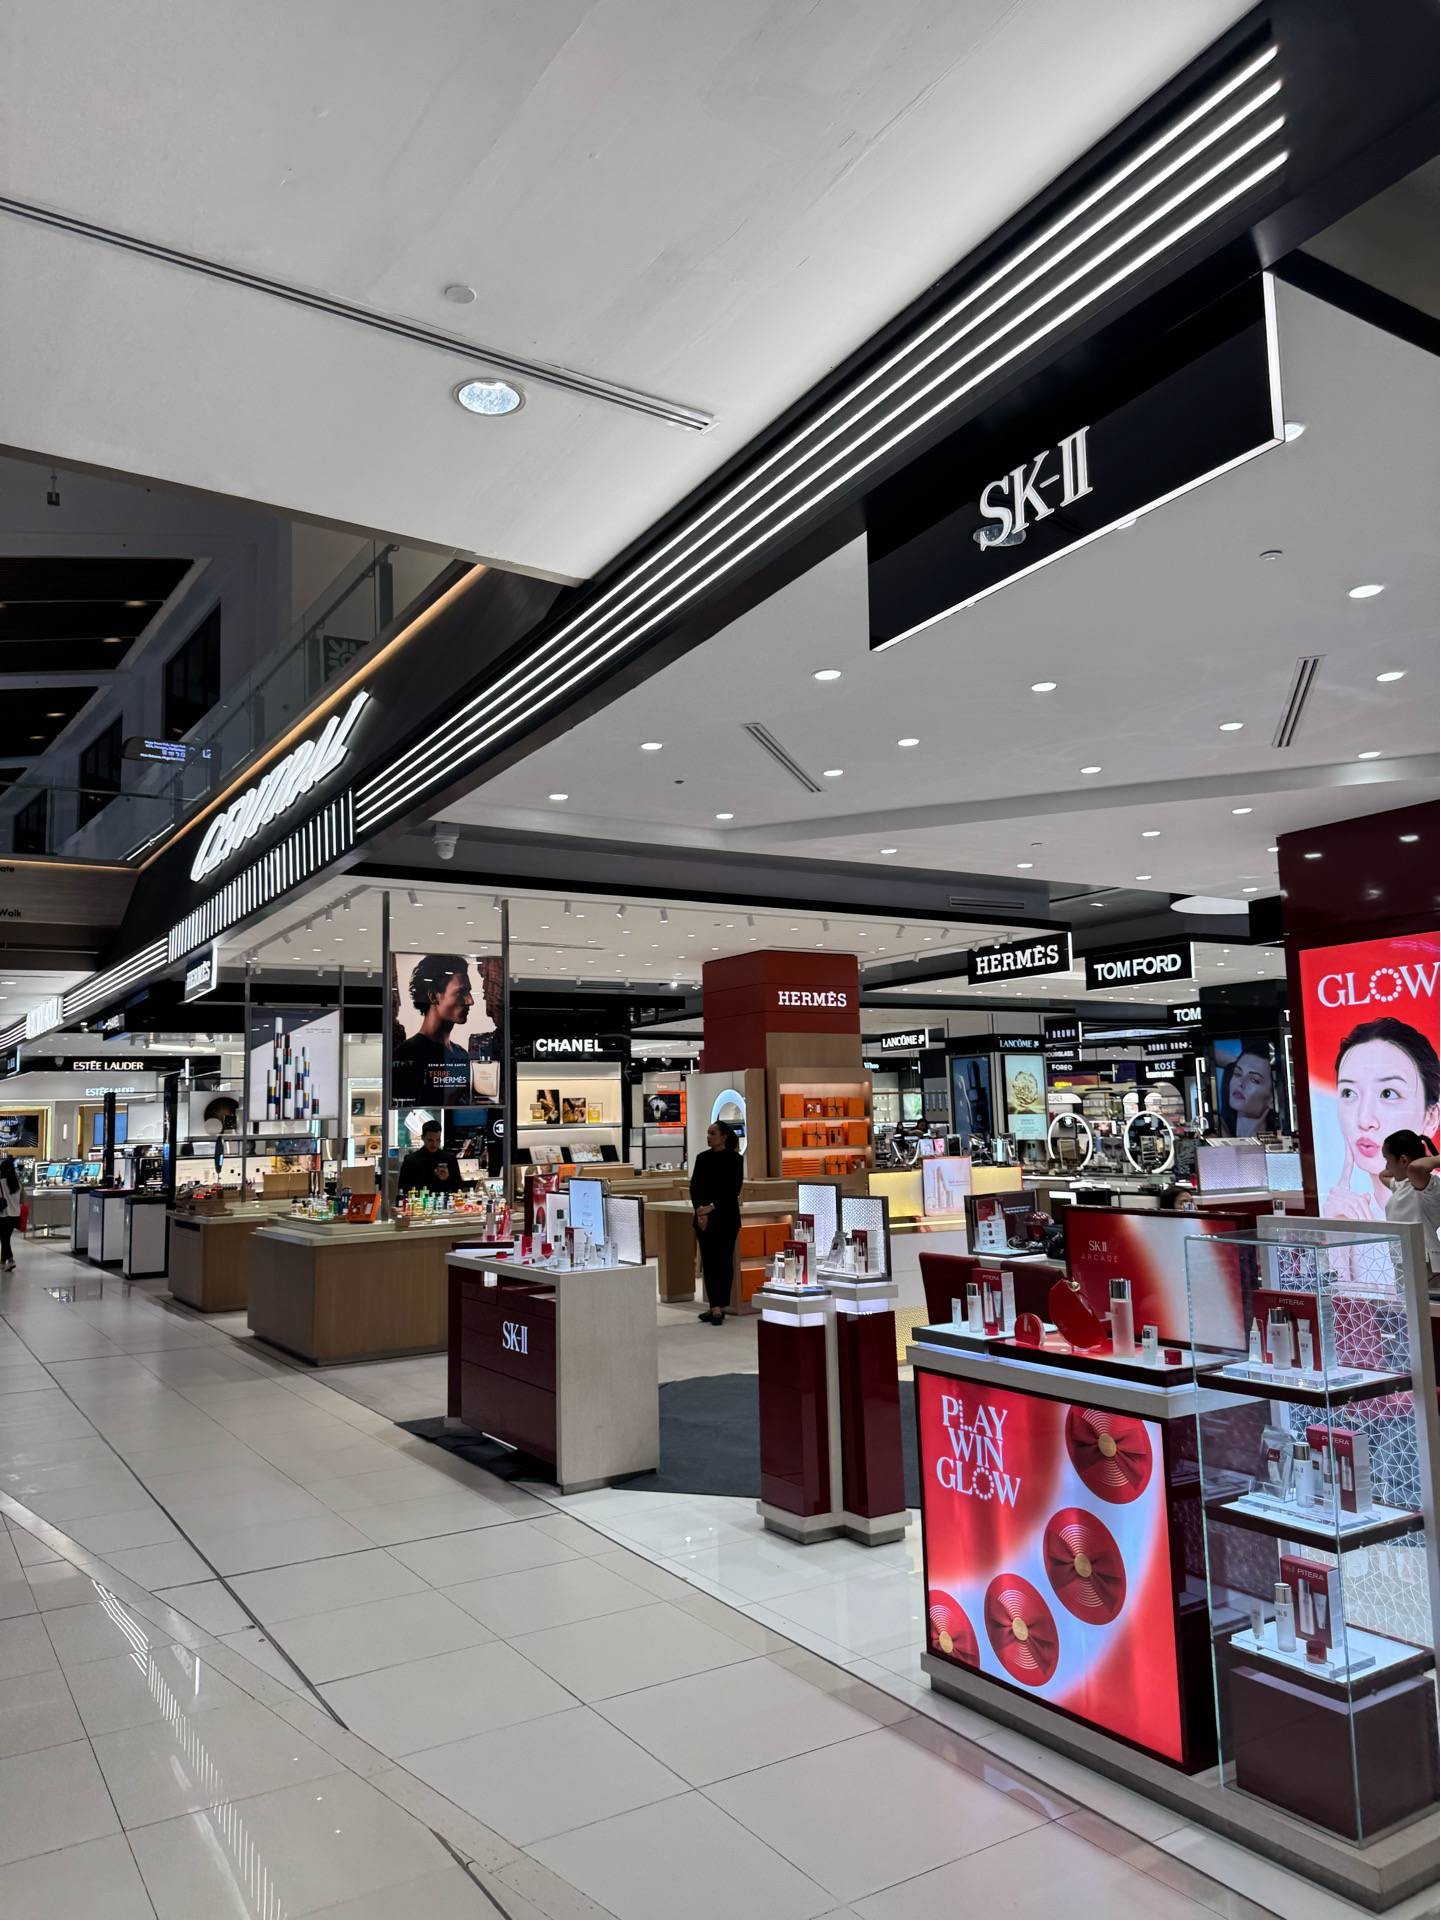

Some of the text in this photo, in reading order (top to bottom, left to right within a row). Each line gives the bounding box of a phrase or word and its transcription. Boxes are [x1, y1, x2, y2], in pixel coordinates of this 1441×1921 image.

[979, 425, 1093, 551] SK-II
[190, 691, 369, 882] CENTRAL
[976, 944, 1060, 975] HERMÈS
[1094, 953, 1182, 980] TOM FORD
[778, 991, 847, 1007] HERMÈS
[1317, 961, 1441, 1008] GLOW
[1173, 1007, 1201, 1022] TOM
[535, 1039, 603, 1052] CHANEL
[882, 1034, 918, 1048] LANCÔME
[1000, 1039, 1033, 1048] LANCÔME
[73, 1060, 144, 1070] ESTÉE LAUDER
[1154, 1060, 1176, 1071] KOSÉ
[502, 1320, 529, 1355] SK-II
[941, 1394, 1008, 1441] PLAY
[948, 1427, 1004, 1472] WIN
[936, 1456, 1021, 1508] GLOW
